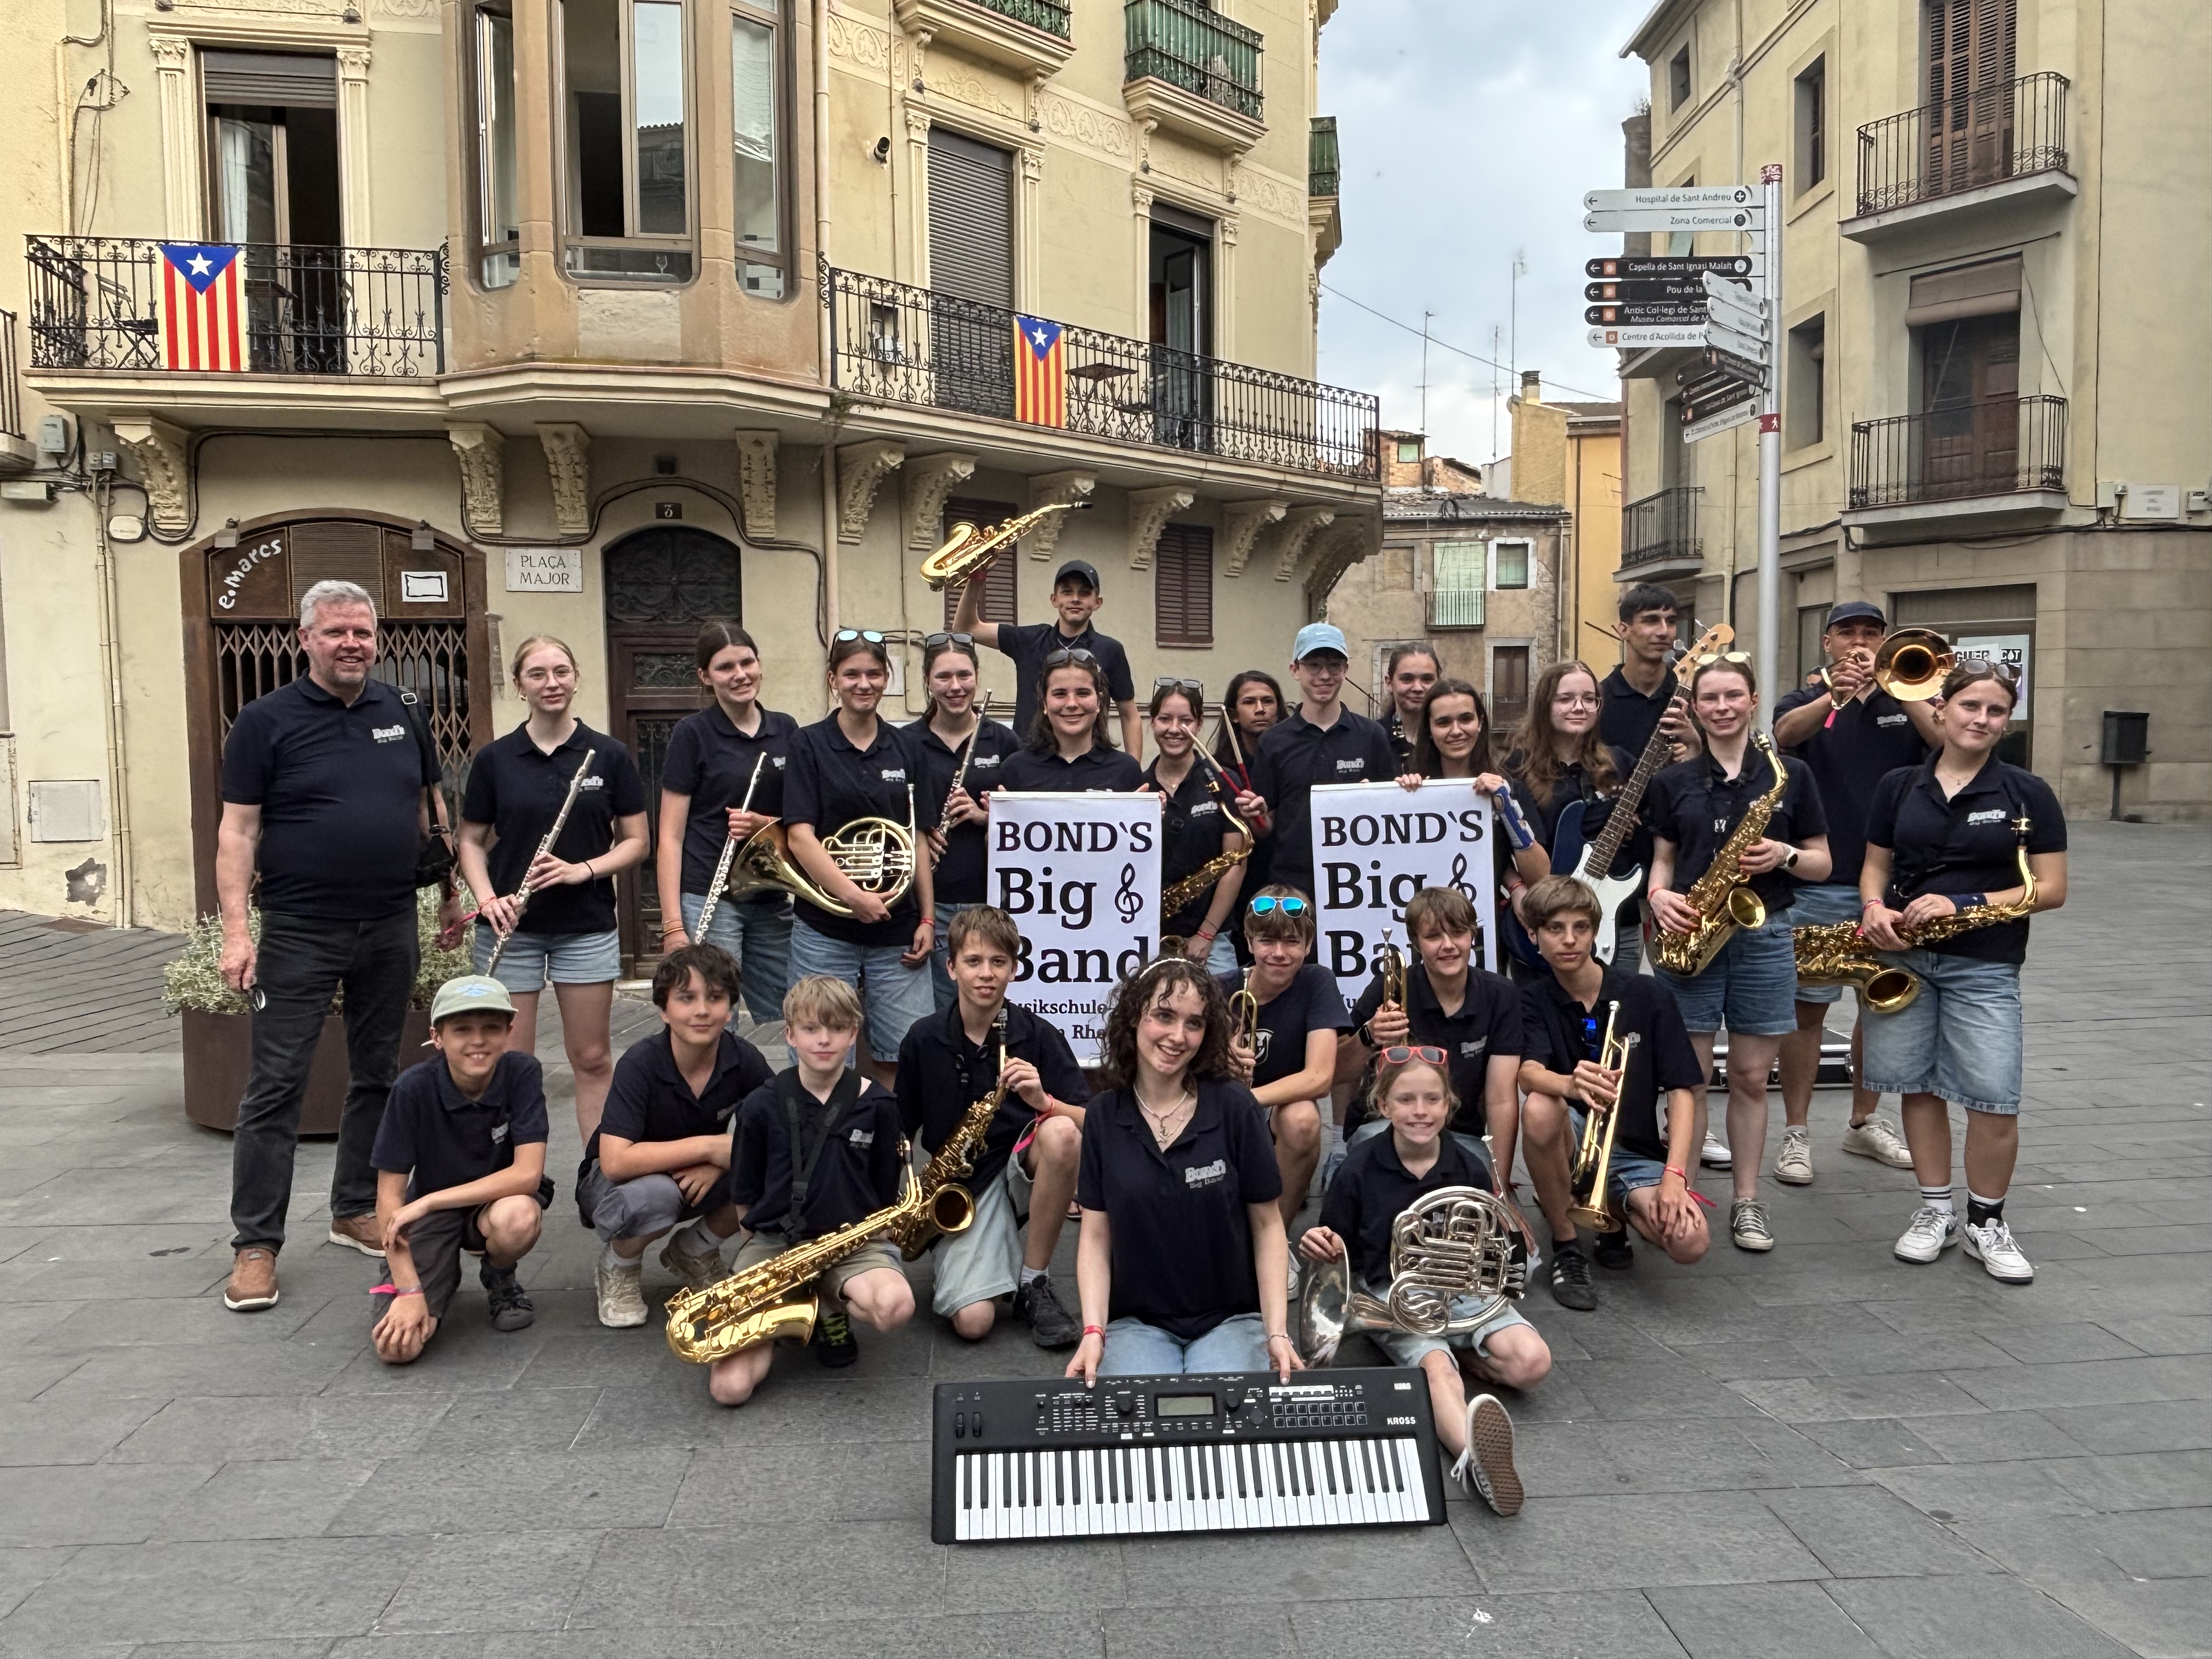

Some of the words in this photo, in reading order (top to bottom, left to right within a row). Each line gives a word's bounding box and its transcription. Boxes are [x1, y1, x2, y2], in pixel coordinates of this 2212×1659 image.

[1636, 195, 1668, 204] Hospital
[1670, 194, 1680, 202] de
[1683, 194, 1700, 202] Sant
[1696, 285, 1702, 293] la
[521, 555, 566, 569] PLAÇA
[520, 572, 570, 585] MAJOR
[995, 866, 1097, 930] Big
[1322, 860, 1427, 923] Big
[1387, 1417, 1416, 1425] KROSS
